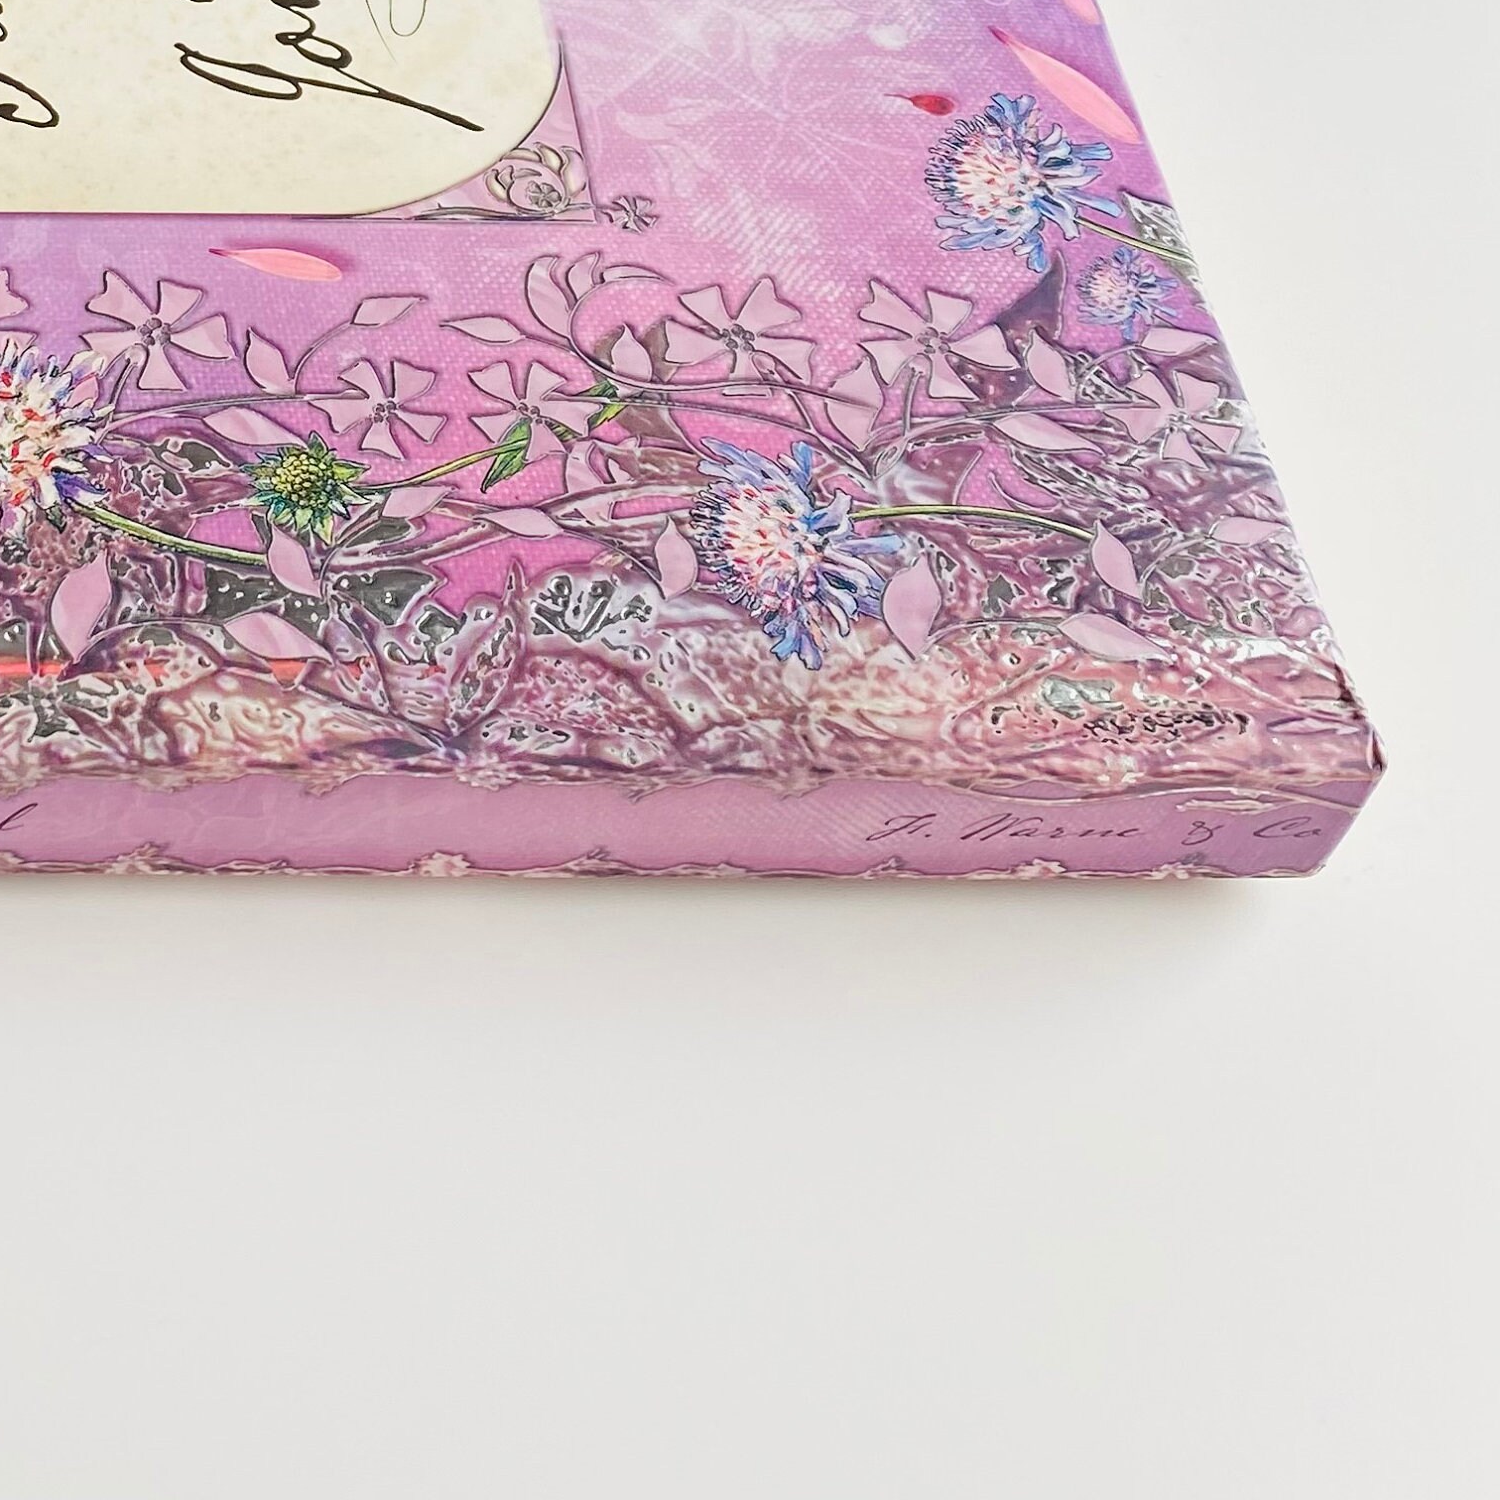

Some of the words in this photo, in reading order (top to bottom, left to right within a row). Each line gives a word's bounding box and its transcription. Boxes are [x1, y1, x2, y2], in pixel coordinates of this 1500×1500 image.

[960, 812, 1145, 842] Warne
[1181, 819, 1222, 846] &
[1252, 816, 1322, 840] Co
